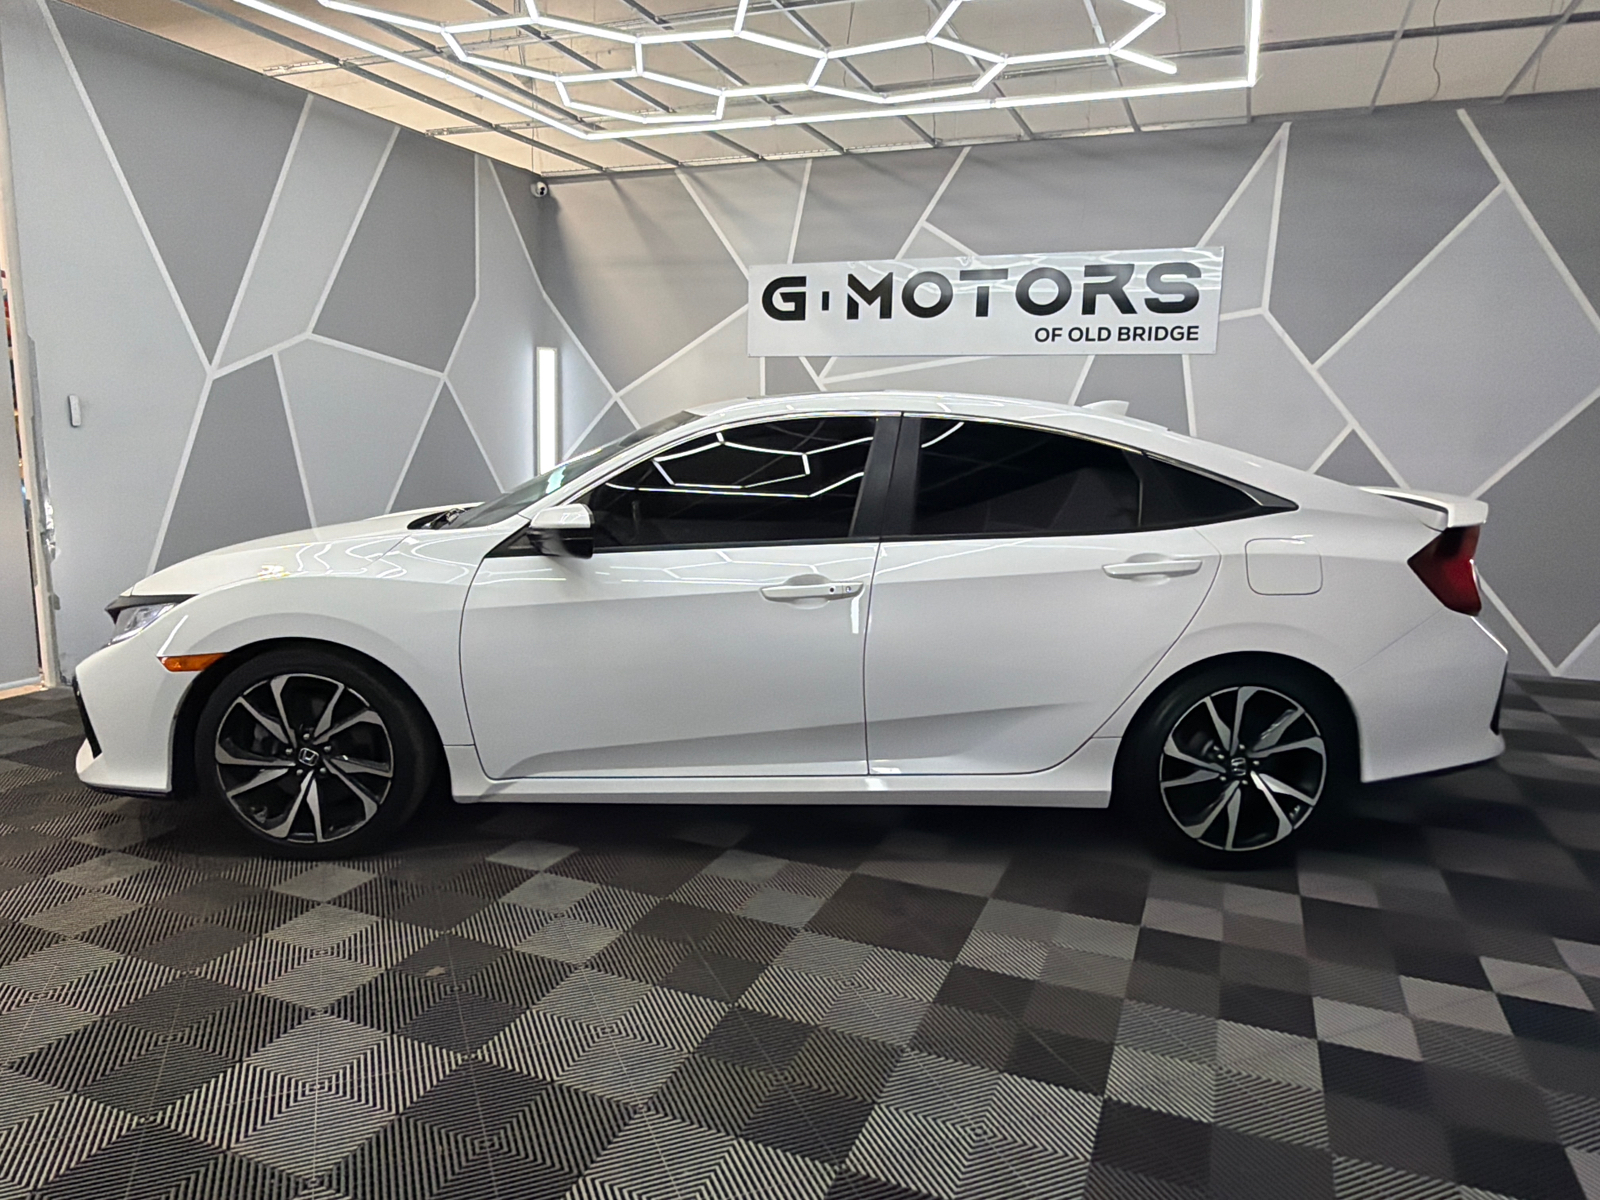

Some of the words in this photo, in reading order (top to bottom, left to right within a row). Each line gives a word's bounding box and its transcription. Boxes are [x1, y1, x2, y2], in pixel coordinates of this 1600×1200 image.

[1034, 327, 1063, 343] OF
[1068, 326, 1112, 342] OLD
[1117, 325, 1200, 341] BRIDGE
